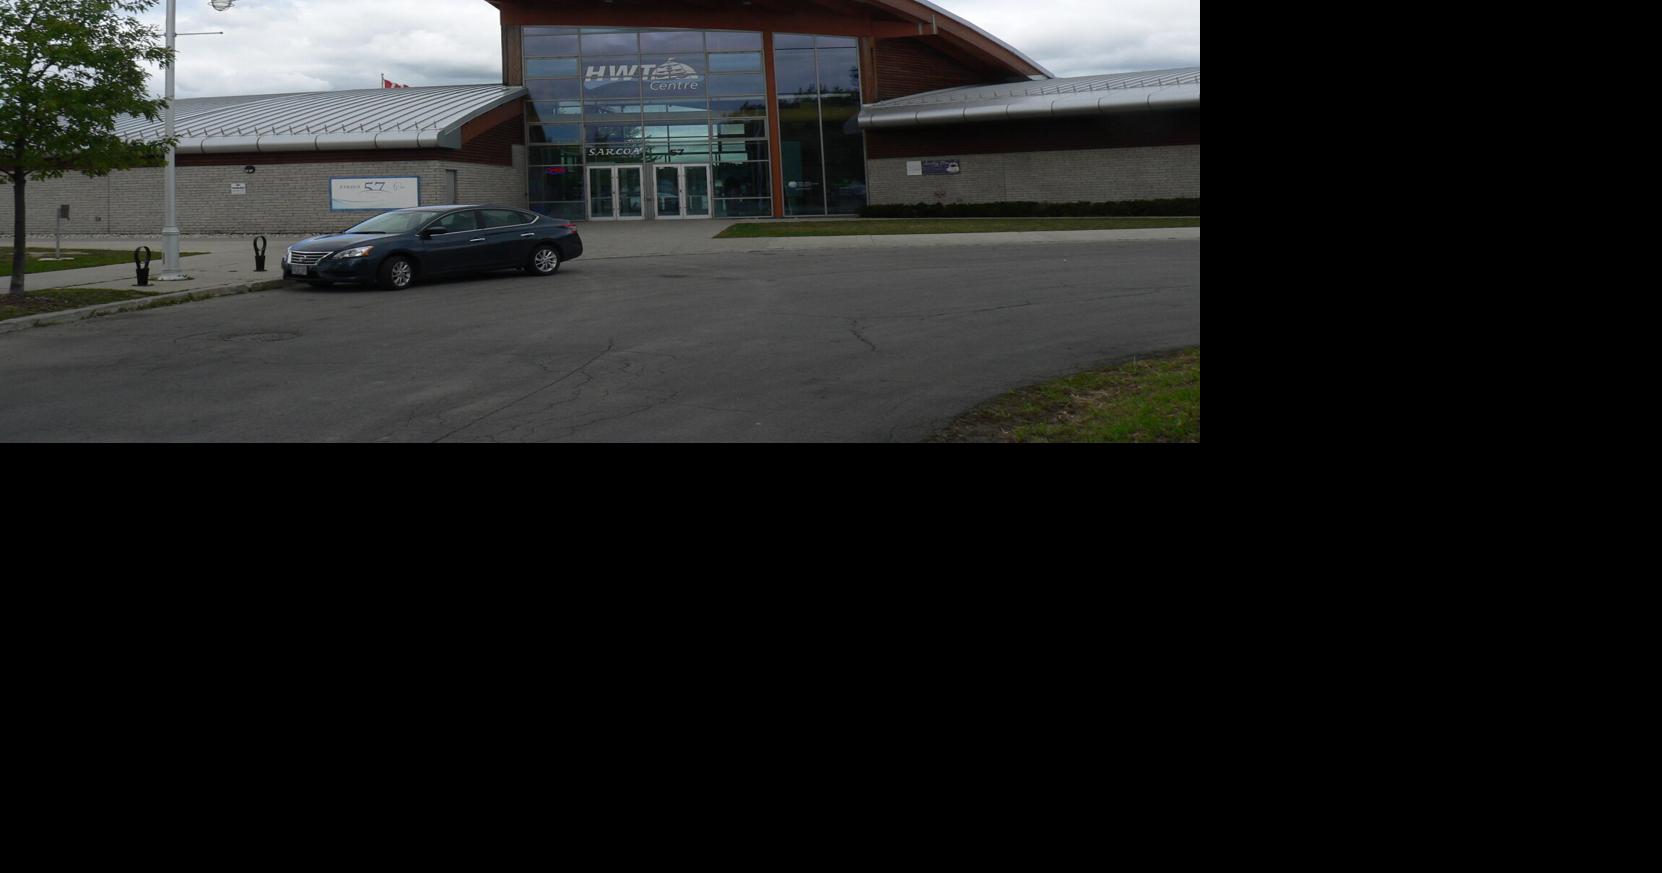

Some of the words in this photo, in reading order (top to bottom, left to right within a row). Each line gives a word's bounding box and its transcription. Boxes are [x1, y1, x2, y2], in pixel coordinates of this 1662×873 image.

[584, 64, 657, 82] HWT
[650, 80, 698, 91] Centre
[364, 181, 386, 192] 57
